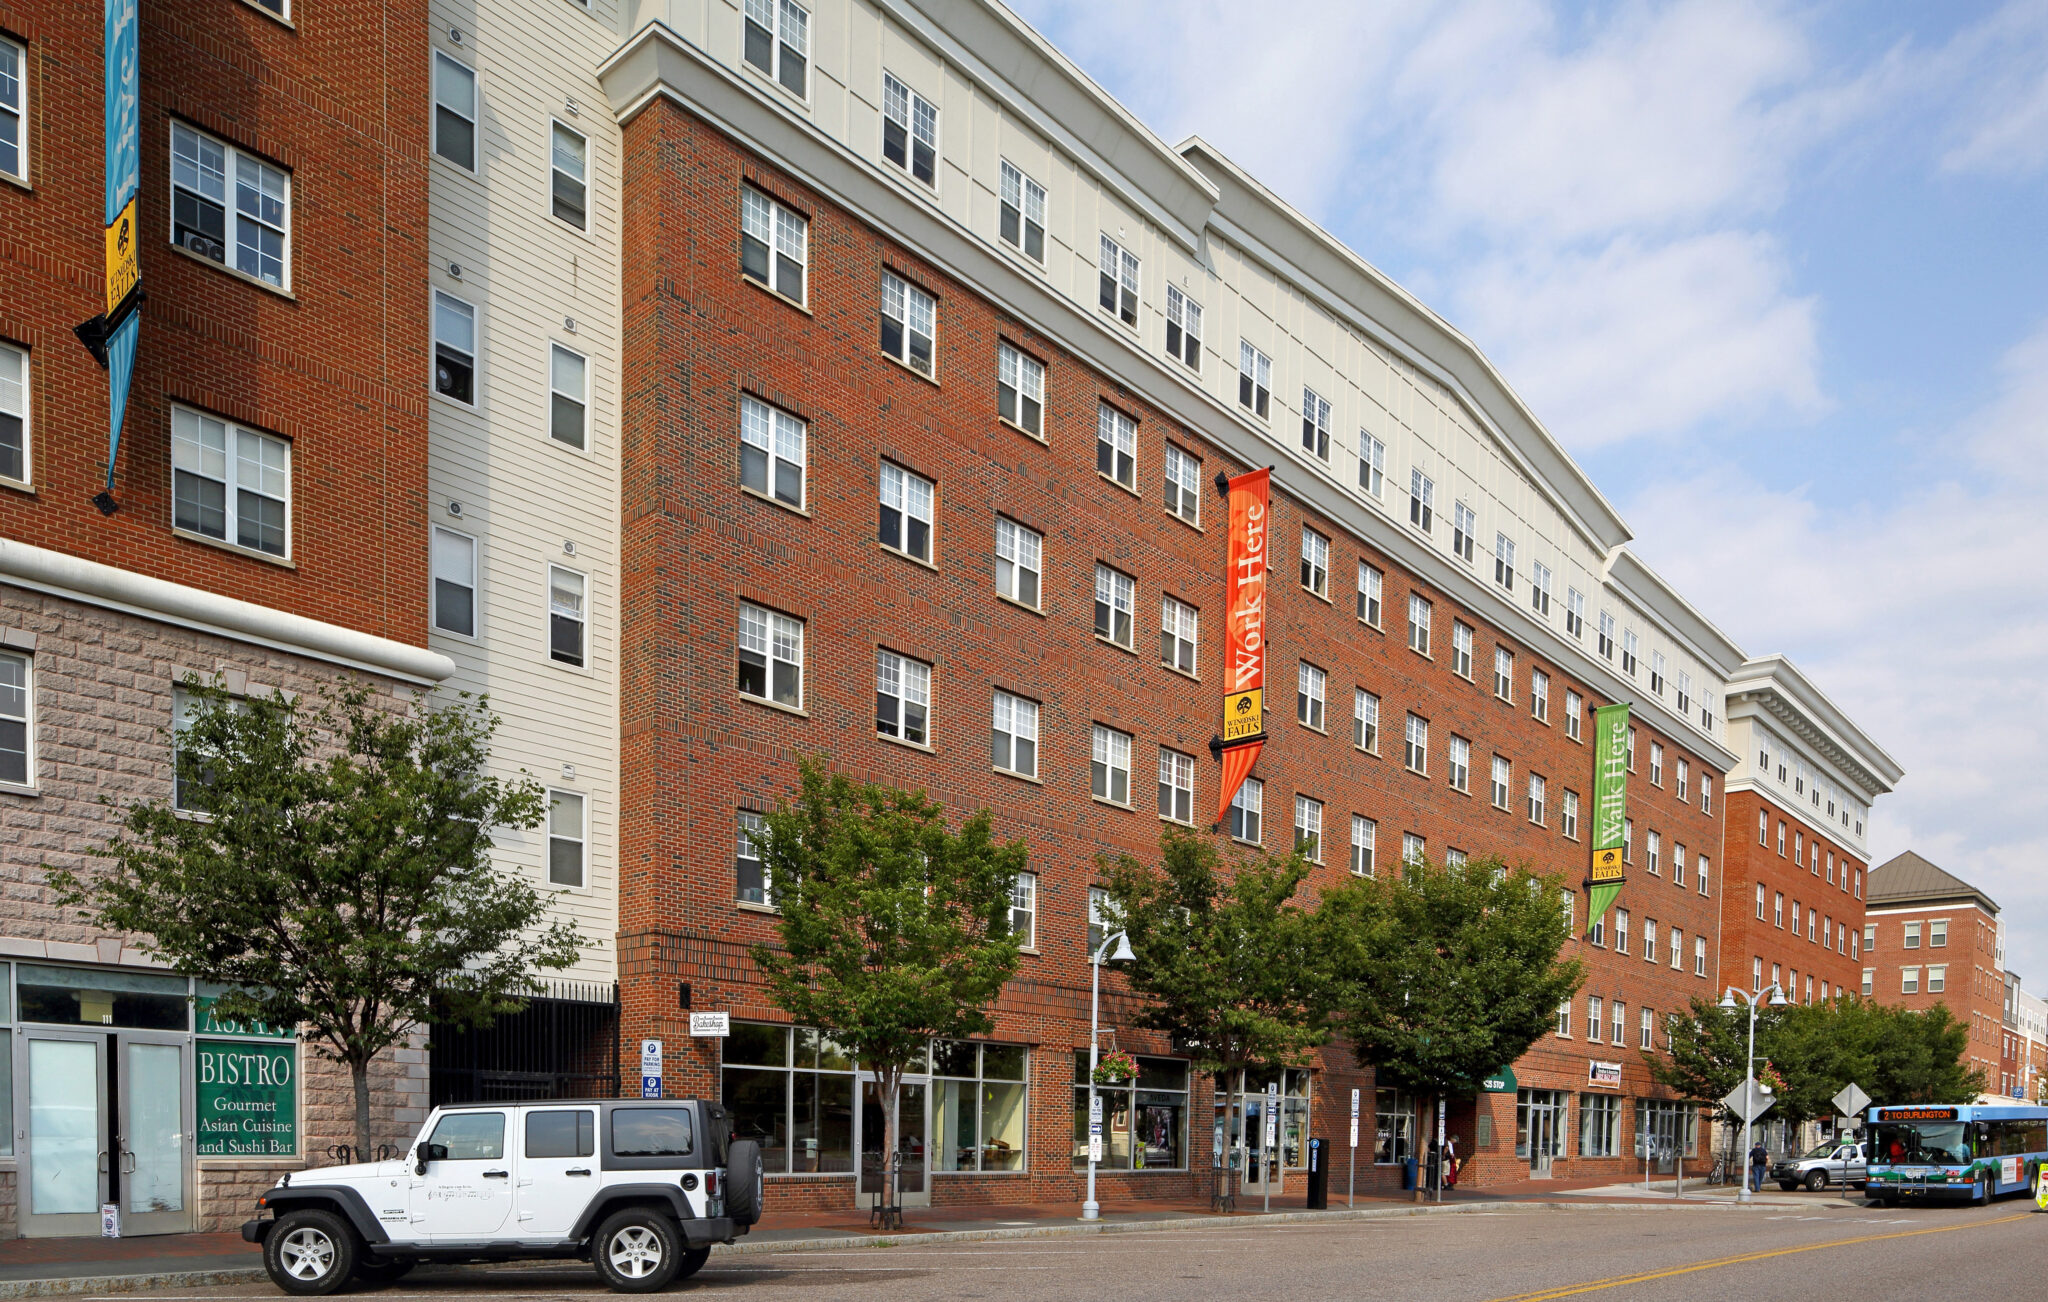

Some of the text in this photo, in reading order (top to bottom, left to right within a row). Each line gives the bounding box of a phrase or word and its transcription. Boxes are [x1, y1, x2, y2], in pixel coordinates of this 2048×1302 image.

[116, 48, 135, 210] Live
[110, 264, 136, 309] FALLS
[1236, 504, 1264, 690] Work Here
[1227, 714, 1259, 727] WINOOSKI
[1228, 722, 1260, 738] FALLS
[1601, 721, 1626, 846] Walk Here
[1595, 870, 1620, 878] FALLS
[102, 1014, 112, 1024] 111
[200, 1052, 290, 1086] BISTRO
[1493, 1081, 1504, 1089] STOP
[214, 1097, 276, 1112] Gourmet
[1884, 1112, 1889, 1120] 2
[1904, 1111, 1951, 1119] BURLINGTON
[200, 1118, 292, 1132] Asian Cuisine
[199, 1139, 292, 1153] and Sushi Bar
